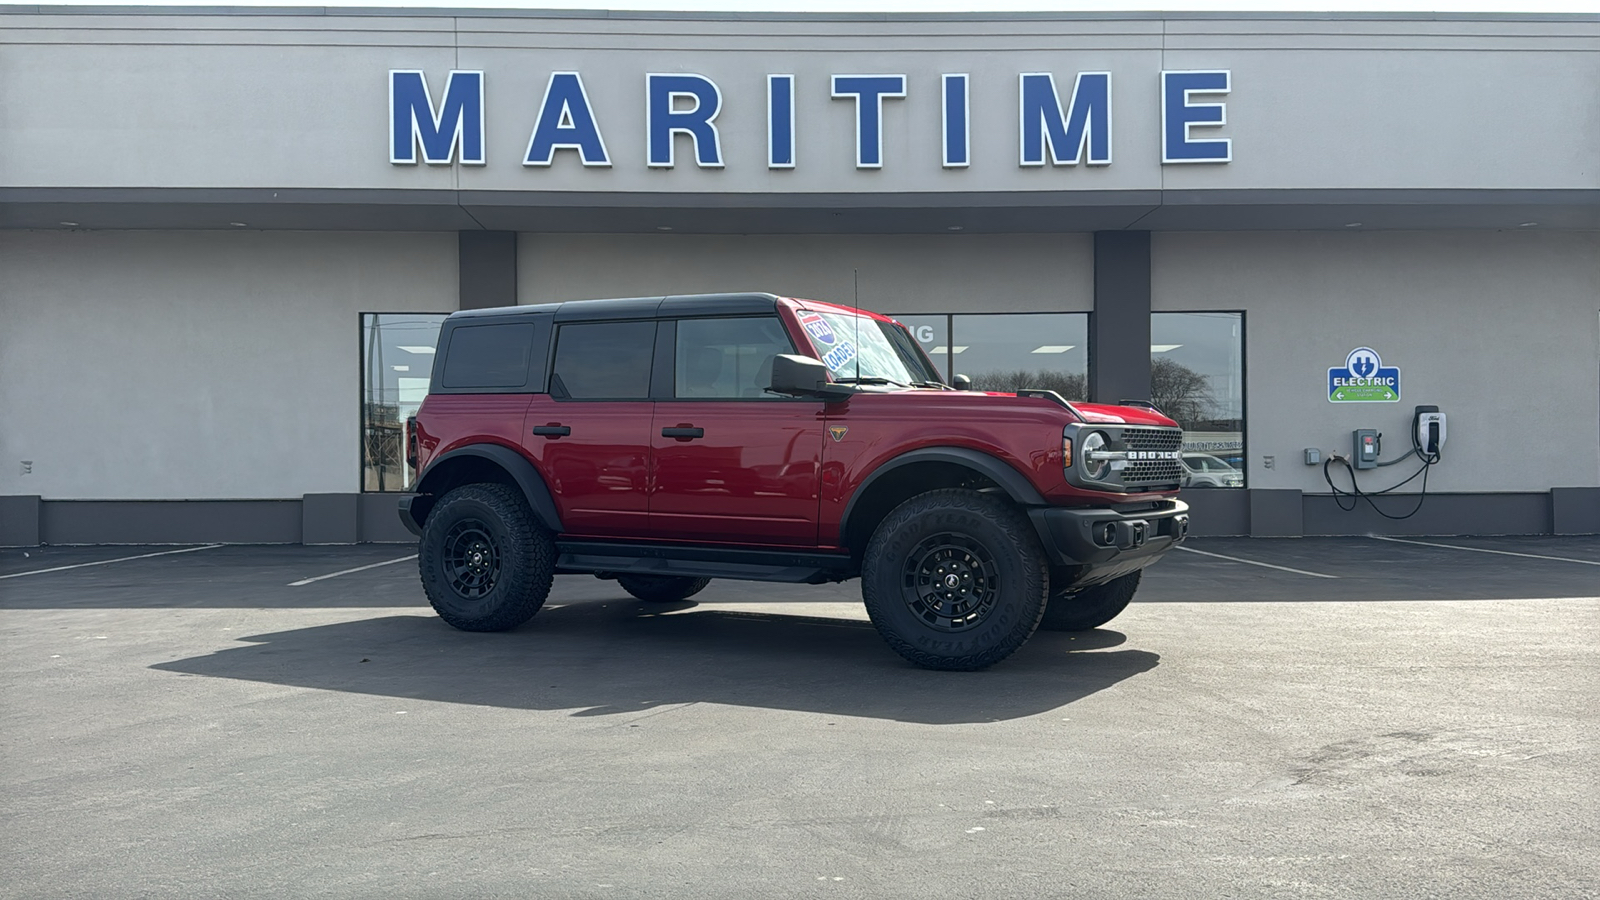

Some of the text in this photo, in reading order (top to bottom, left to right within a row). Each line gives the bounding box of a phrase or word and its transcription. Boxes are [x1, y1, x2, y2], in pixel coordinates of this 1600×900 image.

[388, 69, 1233, 169] MARITIME
[823, 341, 856, 371] LOADED
[1333, 377, 1395, 387] ELECTRIC
[1127, 451, 1179, 460] BRONCO
